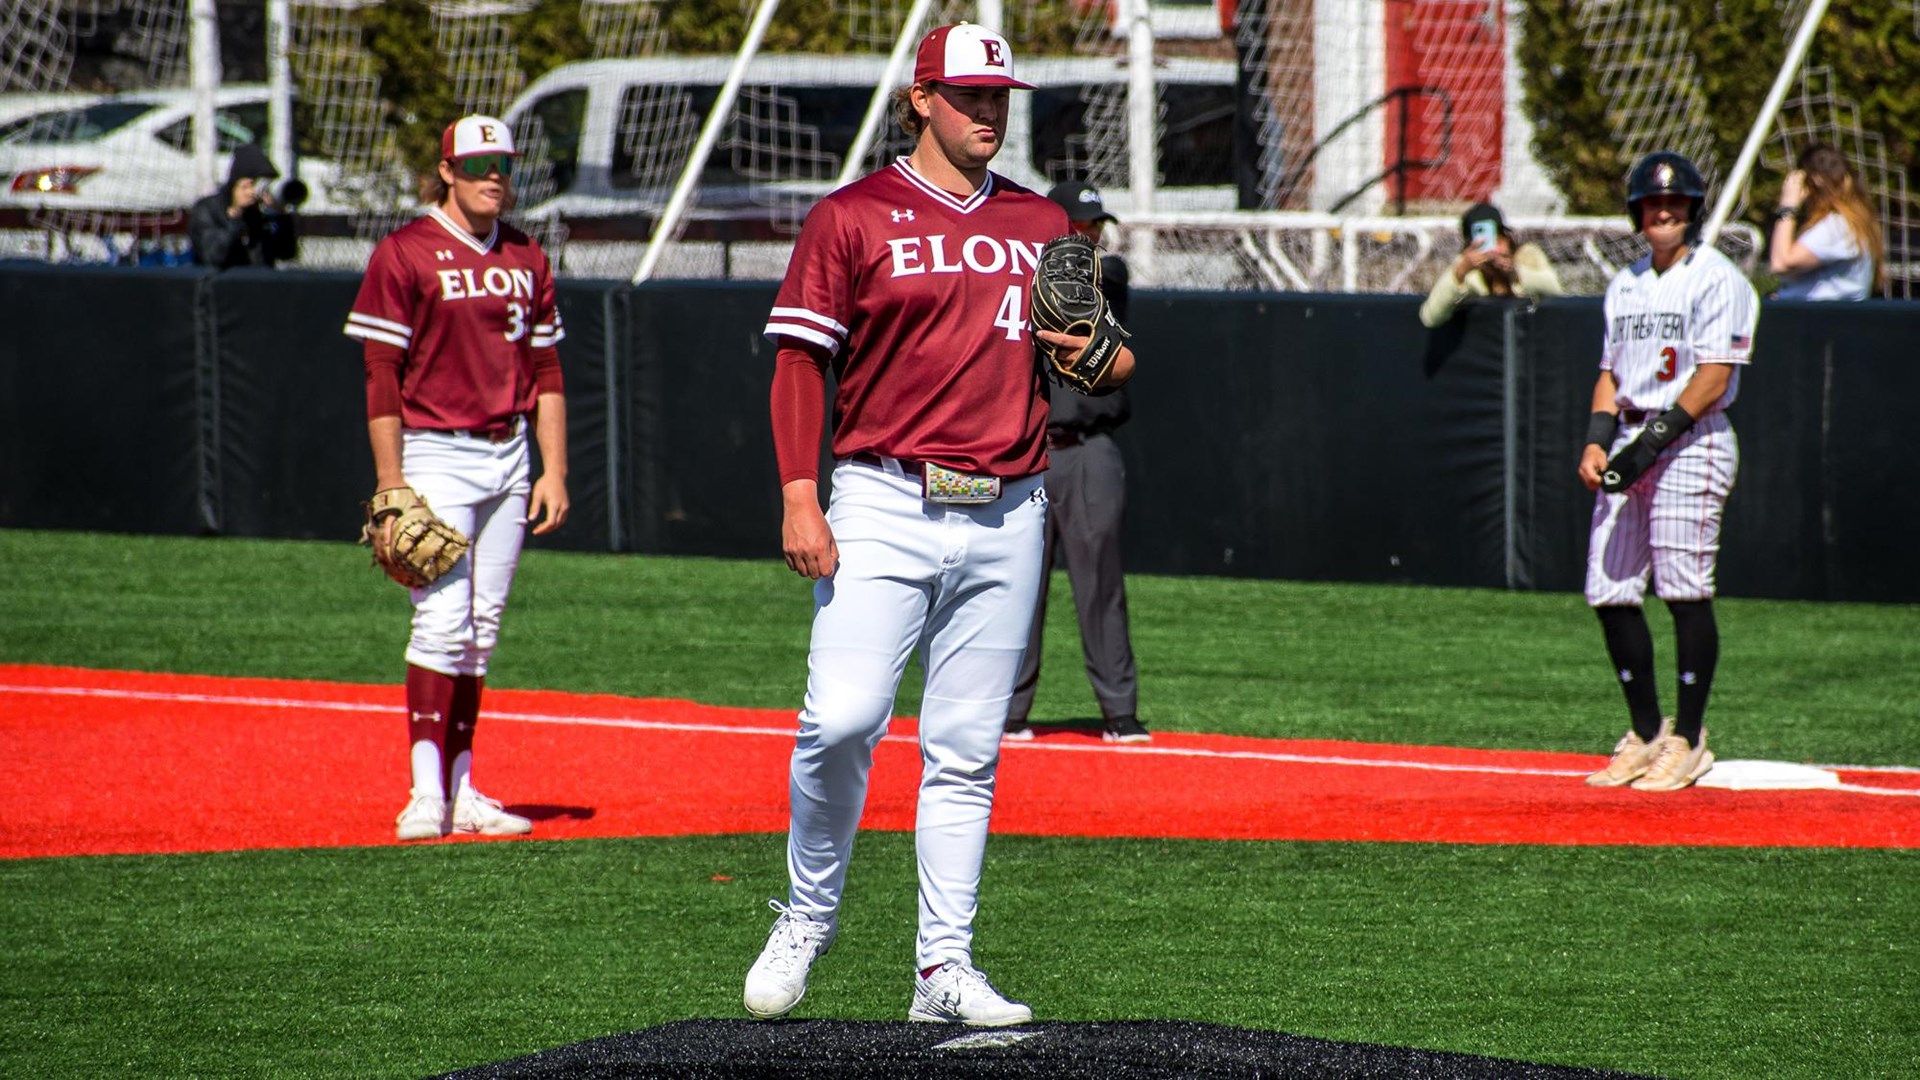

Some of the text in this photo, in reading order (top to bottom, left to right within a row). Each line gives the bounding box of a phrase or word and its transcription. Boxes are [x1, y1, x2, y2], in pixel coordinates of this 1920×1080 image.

[980, 39, 1005, 67] E
[479, 125, 497, 143] E
[886, 234, 1044, 278] ELON
[437, 268, 533, 301] ELON
[504, 301, 531, 342] 3
[993, 284, 1033, 341] 4
[1085, 336, 1110, 368] Wilson
[1655, 346, 1676, 381] 3
